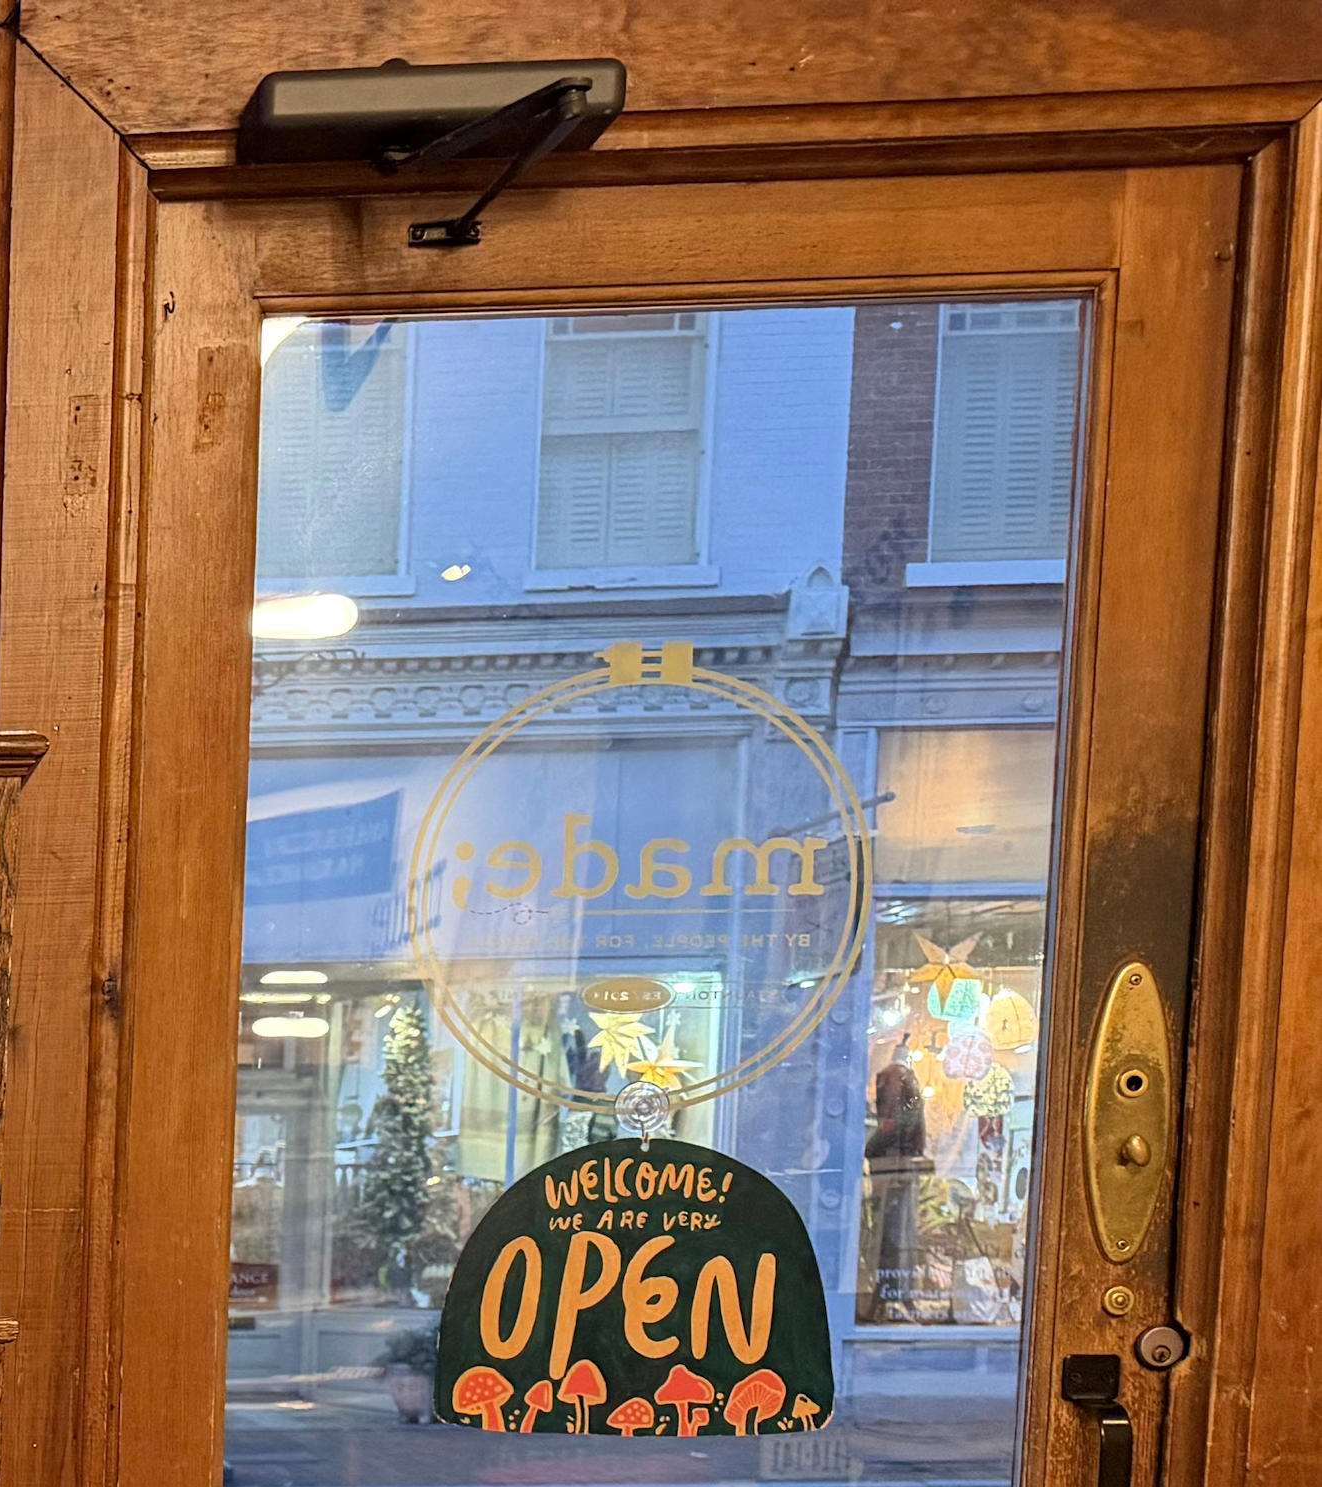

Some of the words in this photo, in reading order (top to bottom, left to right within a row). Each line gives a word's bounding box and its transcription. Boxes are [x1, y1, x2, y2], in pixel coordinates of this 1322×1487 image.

[545, 1157, 733, 1209] WELCOME!
[550, 1213, 582, 1231] WE
[597, 1210, 648, 1231] ARE
[663, 1211, 721, 1231] VERY
[480, 1231, 777, 1380] OPEN
